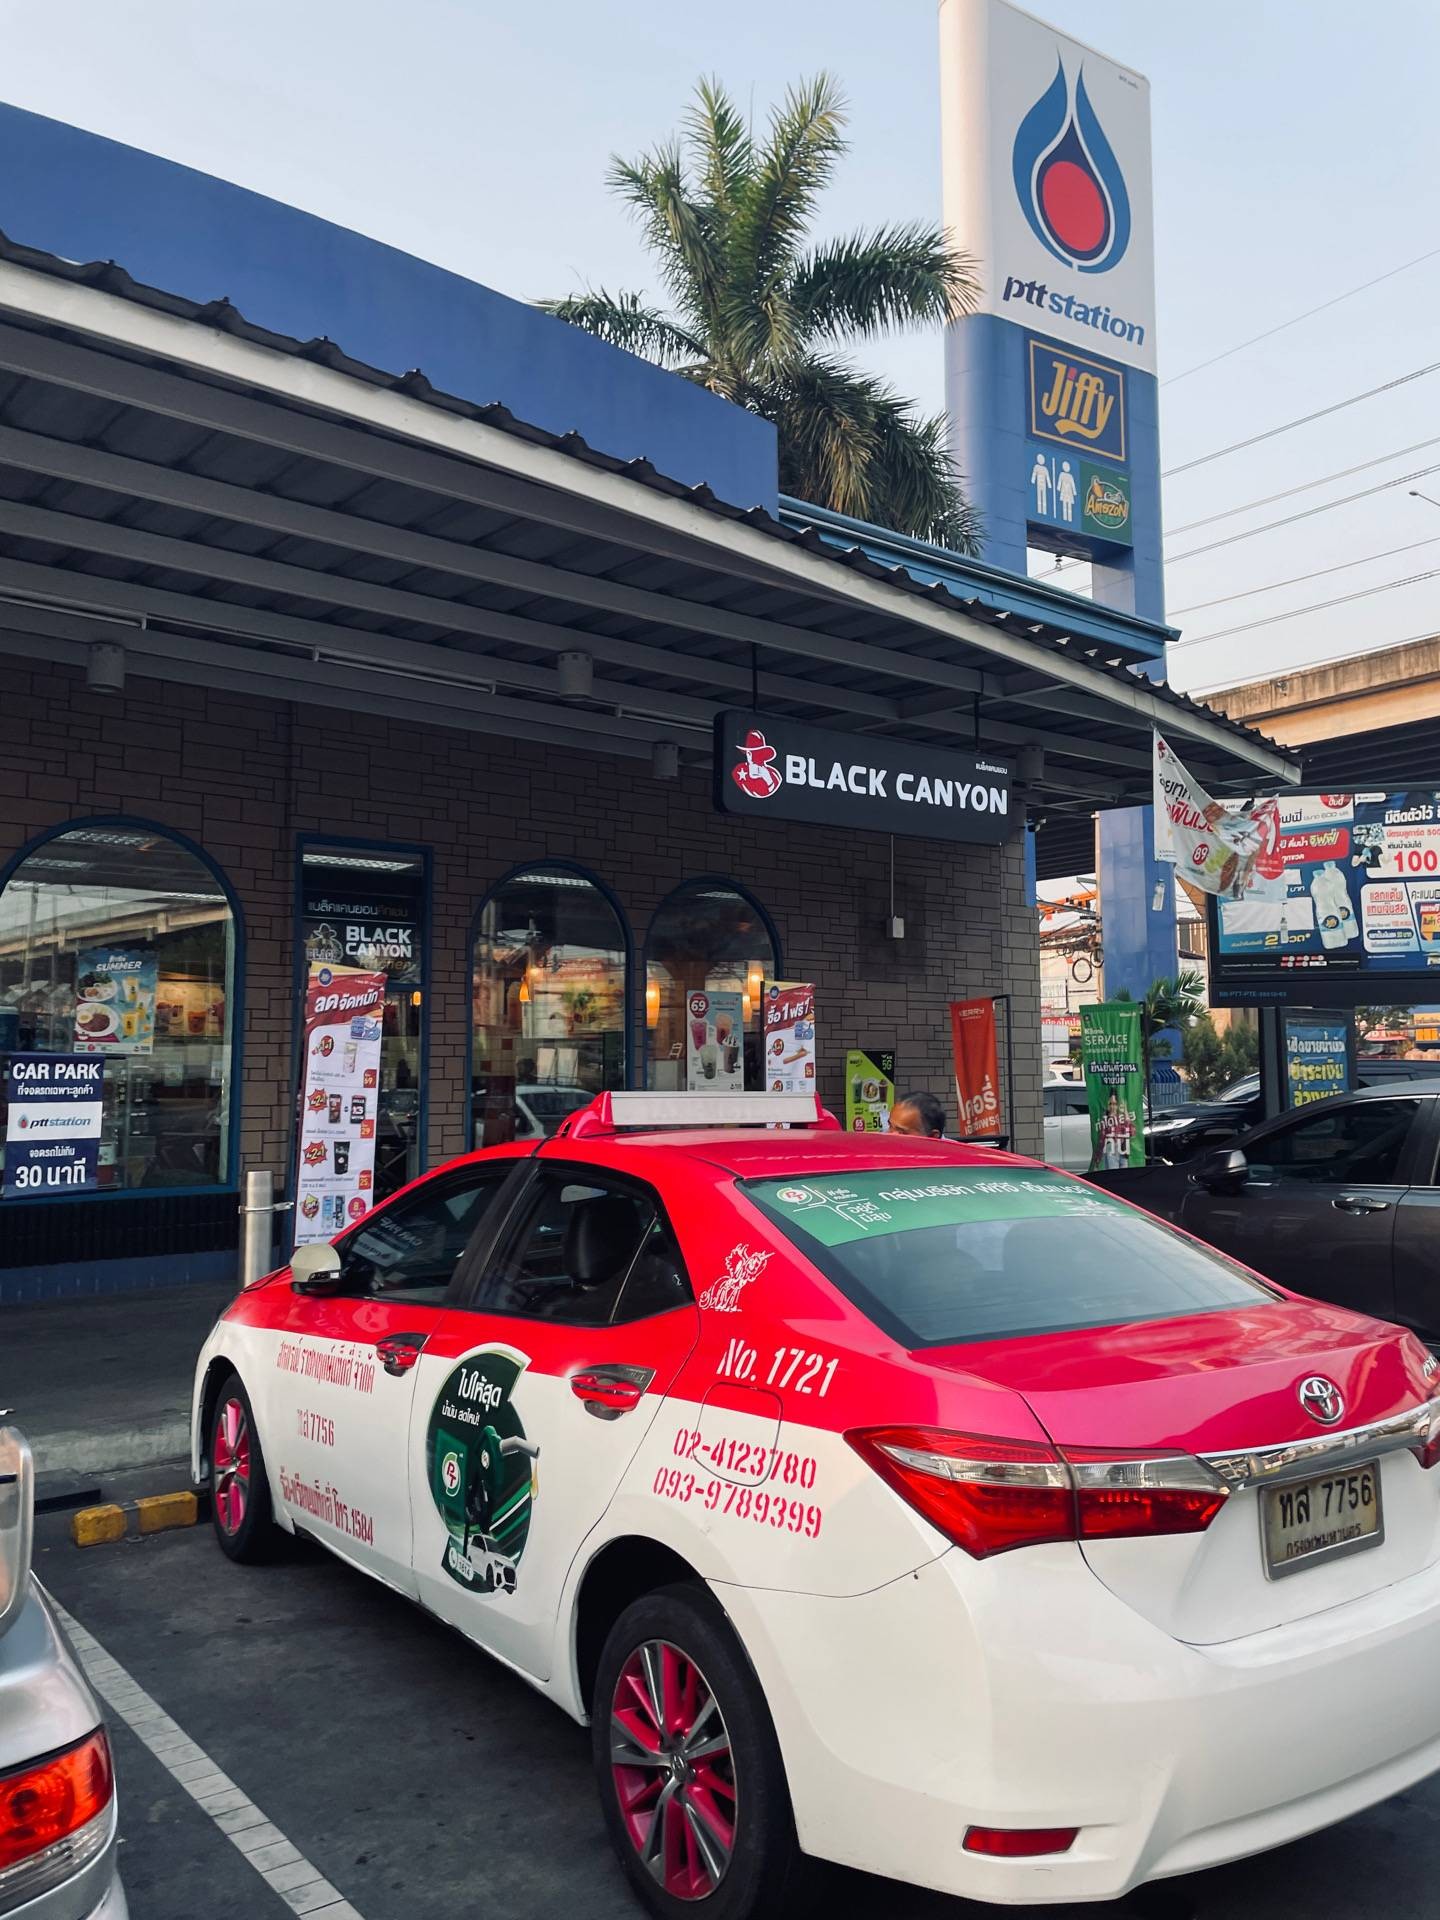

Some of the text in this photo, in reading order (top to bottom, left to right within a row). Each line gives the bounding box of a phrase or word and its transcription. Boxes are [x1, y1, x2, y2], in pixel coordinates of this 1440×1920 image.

[1041, 361, 1115, 439] Jiffy
[785, 754, 1008, 815] BLACK CANYON
[1194, 847, 1208, 865] 89
[1393, 850, 1438, 873] 100
[346, 925, 412, 944] BLACK
[345, 942, 412, 959] CANYON
[96, 960, 142, 972] SUMMER
[1084, 1034, 1128, 1046] SERVICE
[13, 1063, 101, 1080] CAR PARK
[882, 1059, 892, 1071] 5G
[17, 1082, 94, 1098] ที่จอดรถเฉพาะลูกค้า
[29, 1145, 75, 1158] จอดรถไม่เกิน
[15, 1157, 86, 1188] 30 นาที
[878, 1182, 976, 1202] กลุ่มบริษัท
[716, 1338, 840, 1398] No. 1721
[458, 1367, 503, 1412] ไปให้สุด
[441, 1399, 458, 1419] น้ำมัน
[309, 1412, 335, 1447] 7756
[673, 1427, 817, 1489] 02-4123780
[653, 1466, 823, 1539] 093-9789399
[1279, 1473, 1372, 1529] ทล 7756
